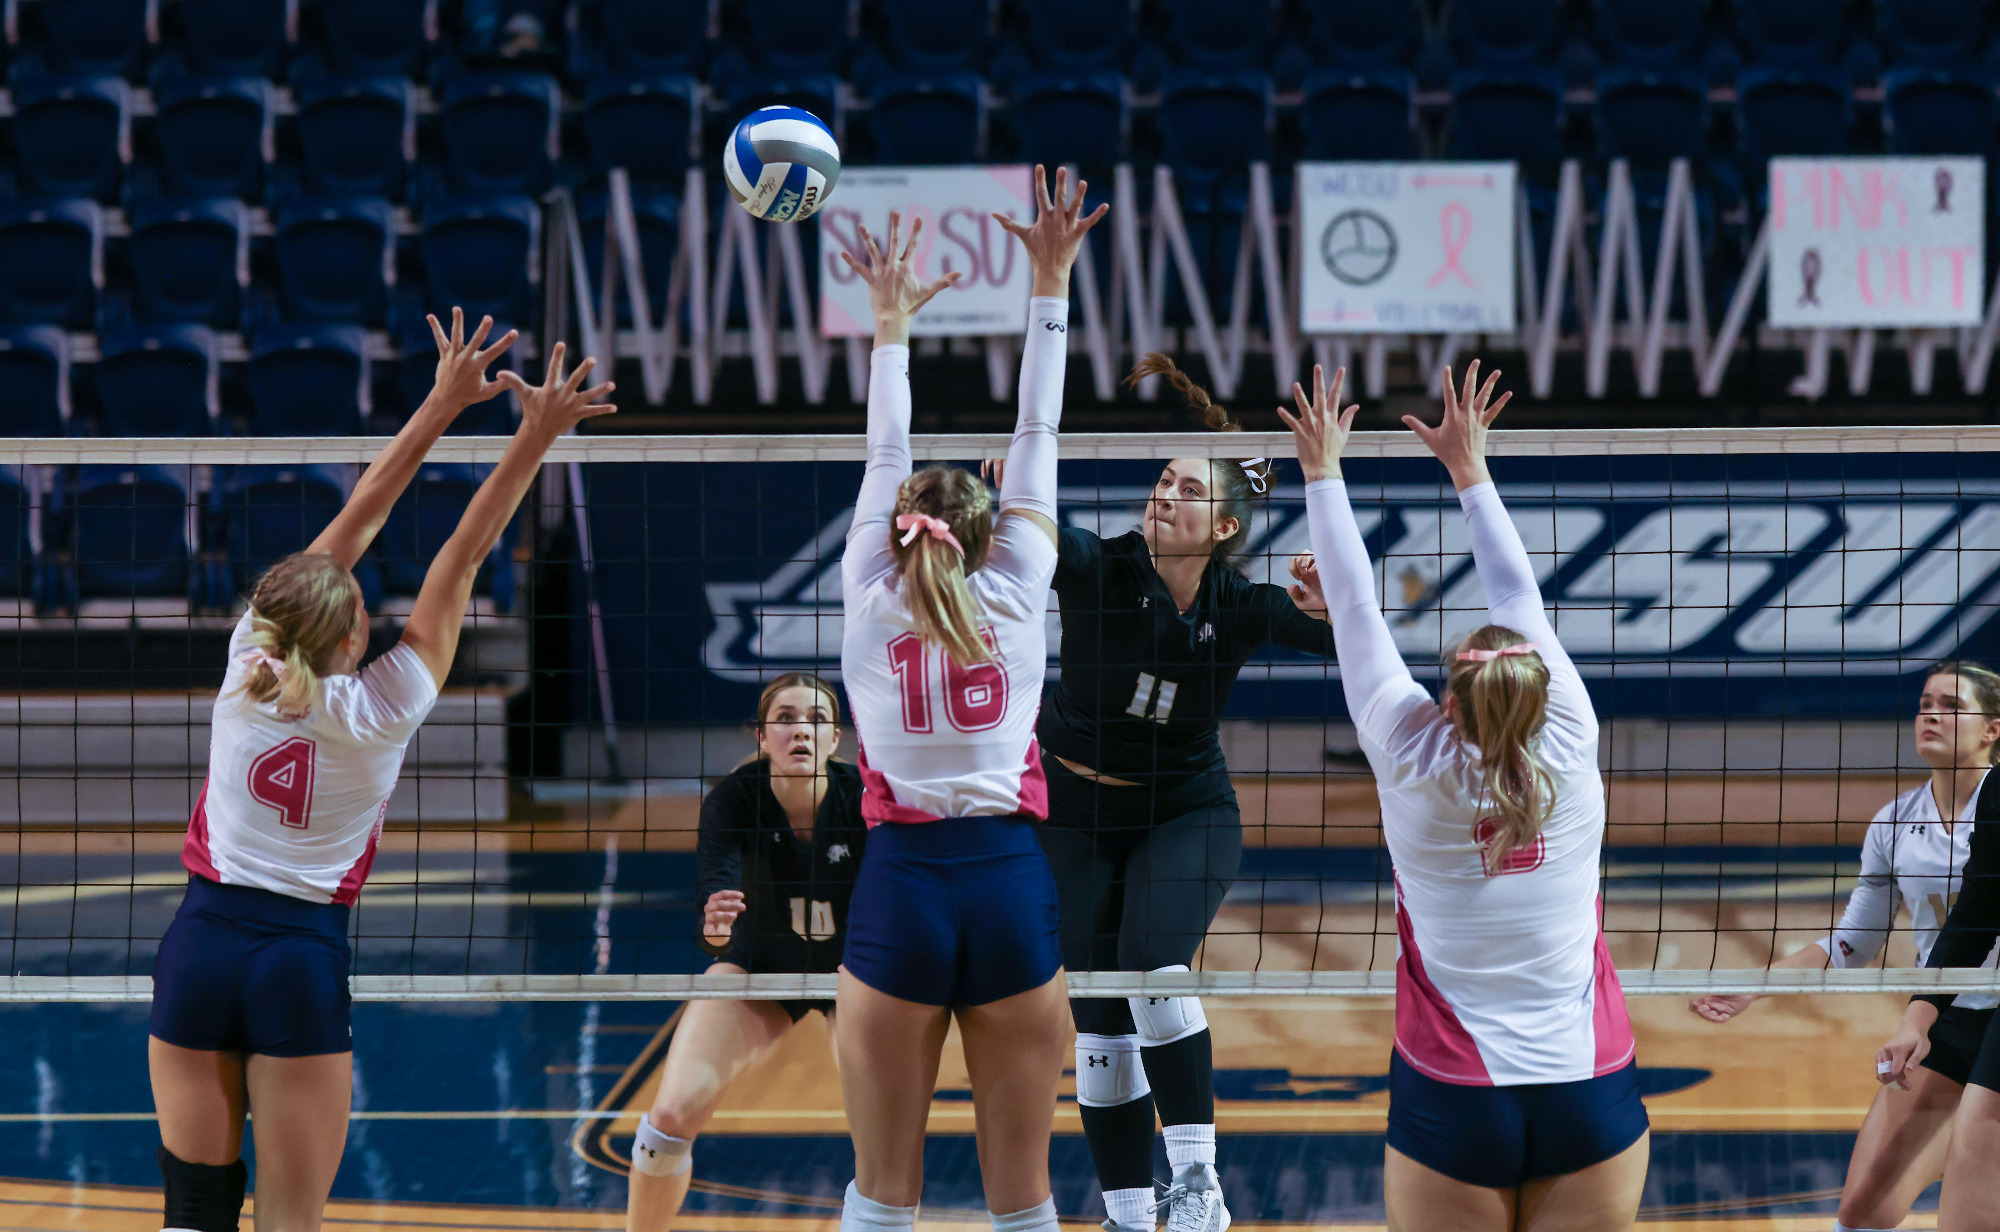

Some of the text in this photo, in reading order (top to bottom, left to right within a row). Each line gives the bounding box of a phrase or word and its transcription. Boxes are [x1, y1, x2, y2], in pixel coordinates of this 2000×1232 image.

[1771, 164, 1909, 232] PINK
[1857, 246, 1981, 310] OUT
[887, 626, 1009, 734] 16
[1125, 672, 1178, 724] 11
[247, 736, 316, 830] 4
[789, 897, 836, 941] 10
